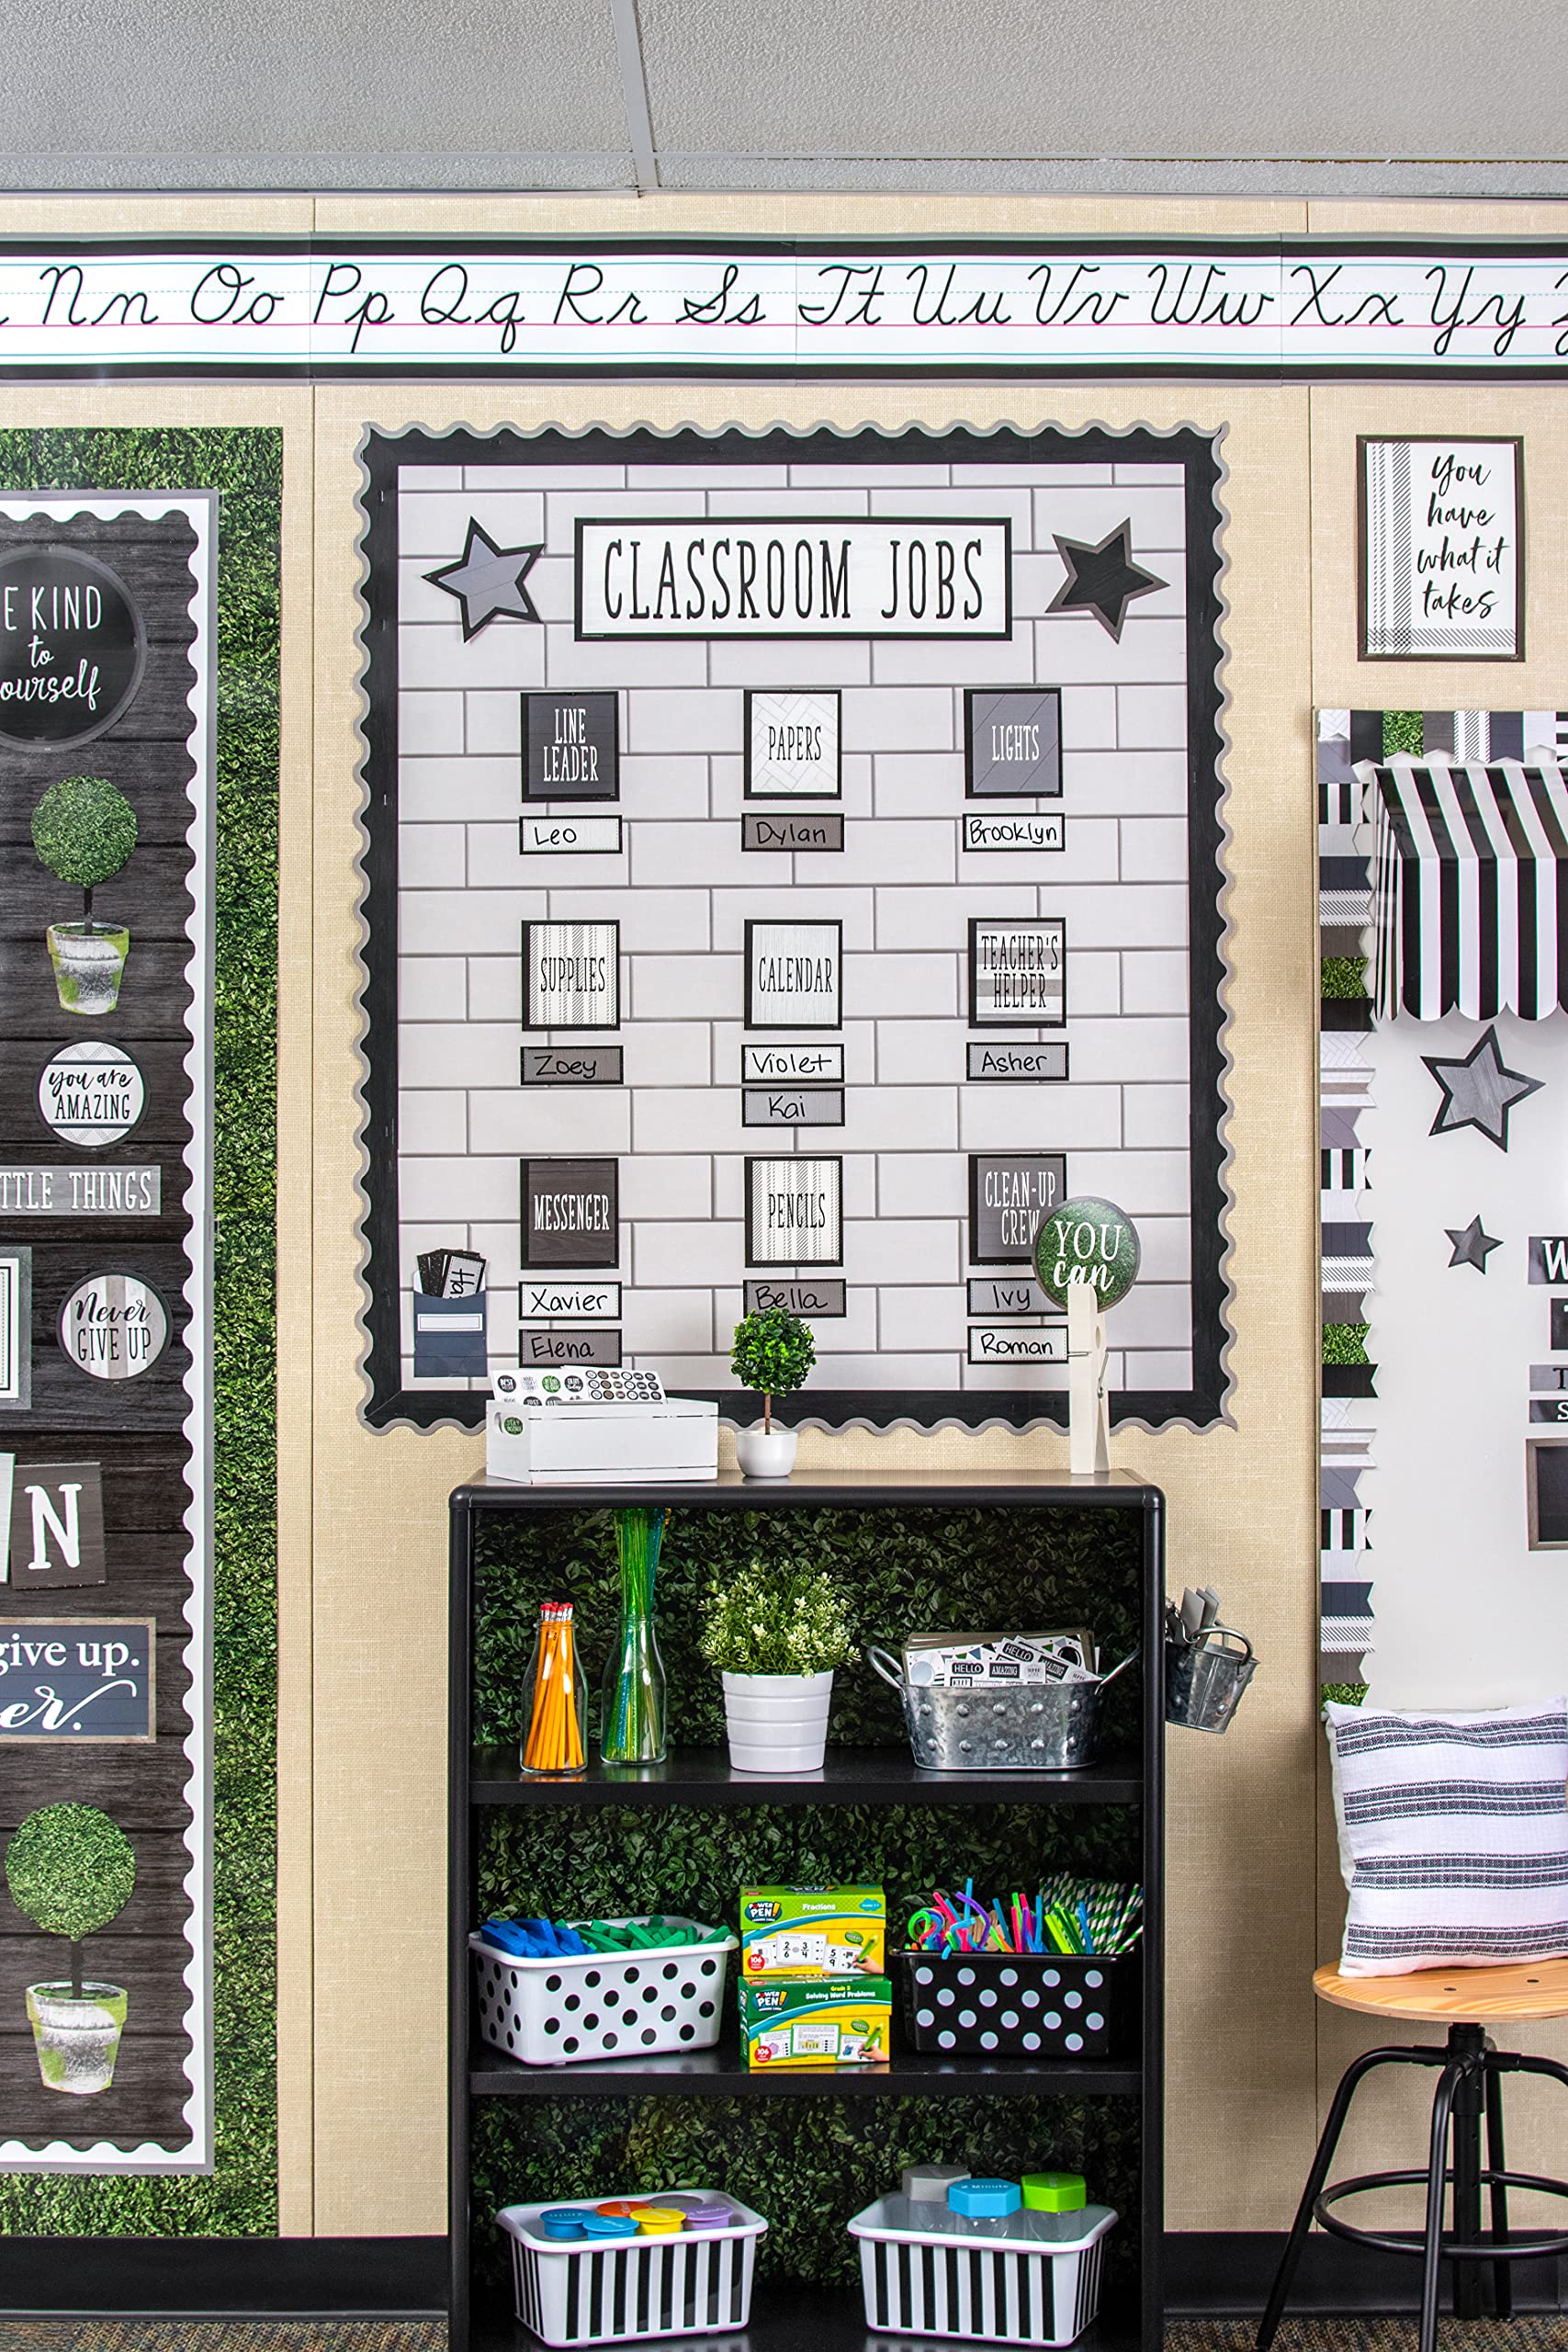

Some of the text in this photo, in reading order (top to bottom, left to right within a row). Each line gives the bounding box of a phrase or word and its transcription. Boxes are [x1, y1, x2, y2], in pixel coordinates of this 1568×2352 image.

[39, 264, 159, 325] Nn
[190, 264, 286, 325] Oo
[312, 264, 395, 354] Pp
[421, 264, 525, 354] Qq
[552, 264, 649, 325] Rr
[675, 264, 768, 325] Ss
[798, 265, 886, 325] Tt
[906, 265, 1011, 324] Uu
[1028, 265, 1130, 324] Vv
[1147, 265, 1275, 325] Ww
[1290, 265, 1404, 325] Xx
[1425, 266, 1527, 356] Yy
[1431, 454, 1492, 496] You
[1427, 492, 1495, 529] have
[1417, 536, 1511, 574] what it
[603, 537, 985, 620] CLASSROOM JOBS
[4, 585, 101, 631] E KIND
[1422, 580, 1499, 619] takes
[28, 634, 54, 668] to
[0, 659, 101, 711] ourself
[554, 707, 587, 744] LINE
[991, 724, 1040, 762] LIGHTS
[768, 725, 822, 762] PAPERS
[543, 745, 599, 782] LEADER
[534, 826, 578, 846] Leo
[755, 821, 827, 845] Dylan
[969, 819, 1057, 845] Brooklyn
[981, 934, 1058, 971] TEACHER'S
[539, 956, 606, 993] SUPPLIES
[759, 956, 833, 993] CALENDAR
[993, 972, 1046, 1008] HELPER
[534, 1055, 597, 1080] Zoey
[751, 1052, 832, 1074] Violet
[981, 1051, 1047, 1073] Asher
[49, 1069, 134, 1098] you are
[54, 1094, 130, 1120] AMAZING
[768, 1095, 806, 1119] Kai
[69, 1170, 152, 1210] THINGS
[985, 1170, 1055, 1207] CLEAN-UP
[534, 1193, 611, 1231] MESSENGER
[767, 1193, 826, 1228] PENCILS
[1001, 1209, 1041, 1245] CREW
[1054, 1219, 1123, 1261] YOU
[1053, 1260, 1115, 1293] can
[75, 1292, 151, 1323] Never
[530, 1288, 608, 1313] Xavier
[755, 1285, 829, 1310] Bella
[992, 1284, 1031, 1311] Ivy
[77, 1327, 152, 1362] GIVE UP
[531, 1336, 594, 1359] Elena
[980, 1332, 1054, 1355] Roman
[24, 1483, 83, 1570] N
[75, 1642, 140, 1677] up.
[954, 1664, 982, 1673] HELLO
[1005, 1644, 1032, 1661] HELLO
[992, 1665, 1018, 1676] AMAZING
[829, 1959, 836, 1967] 9
[830, 1949, 837, 1957] 5
[806, 1992, 829, 2000] Solving
[847, 1990, 875, 1998] Problems
